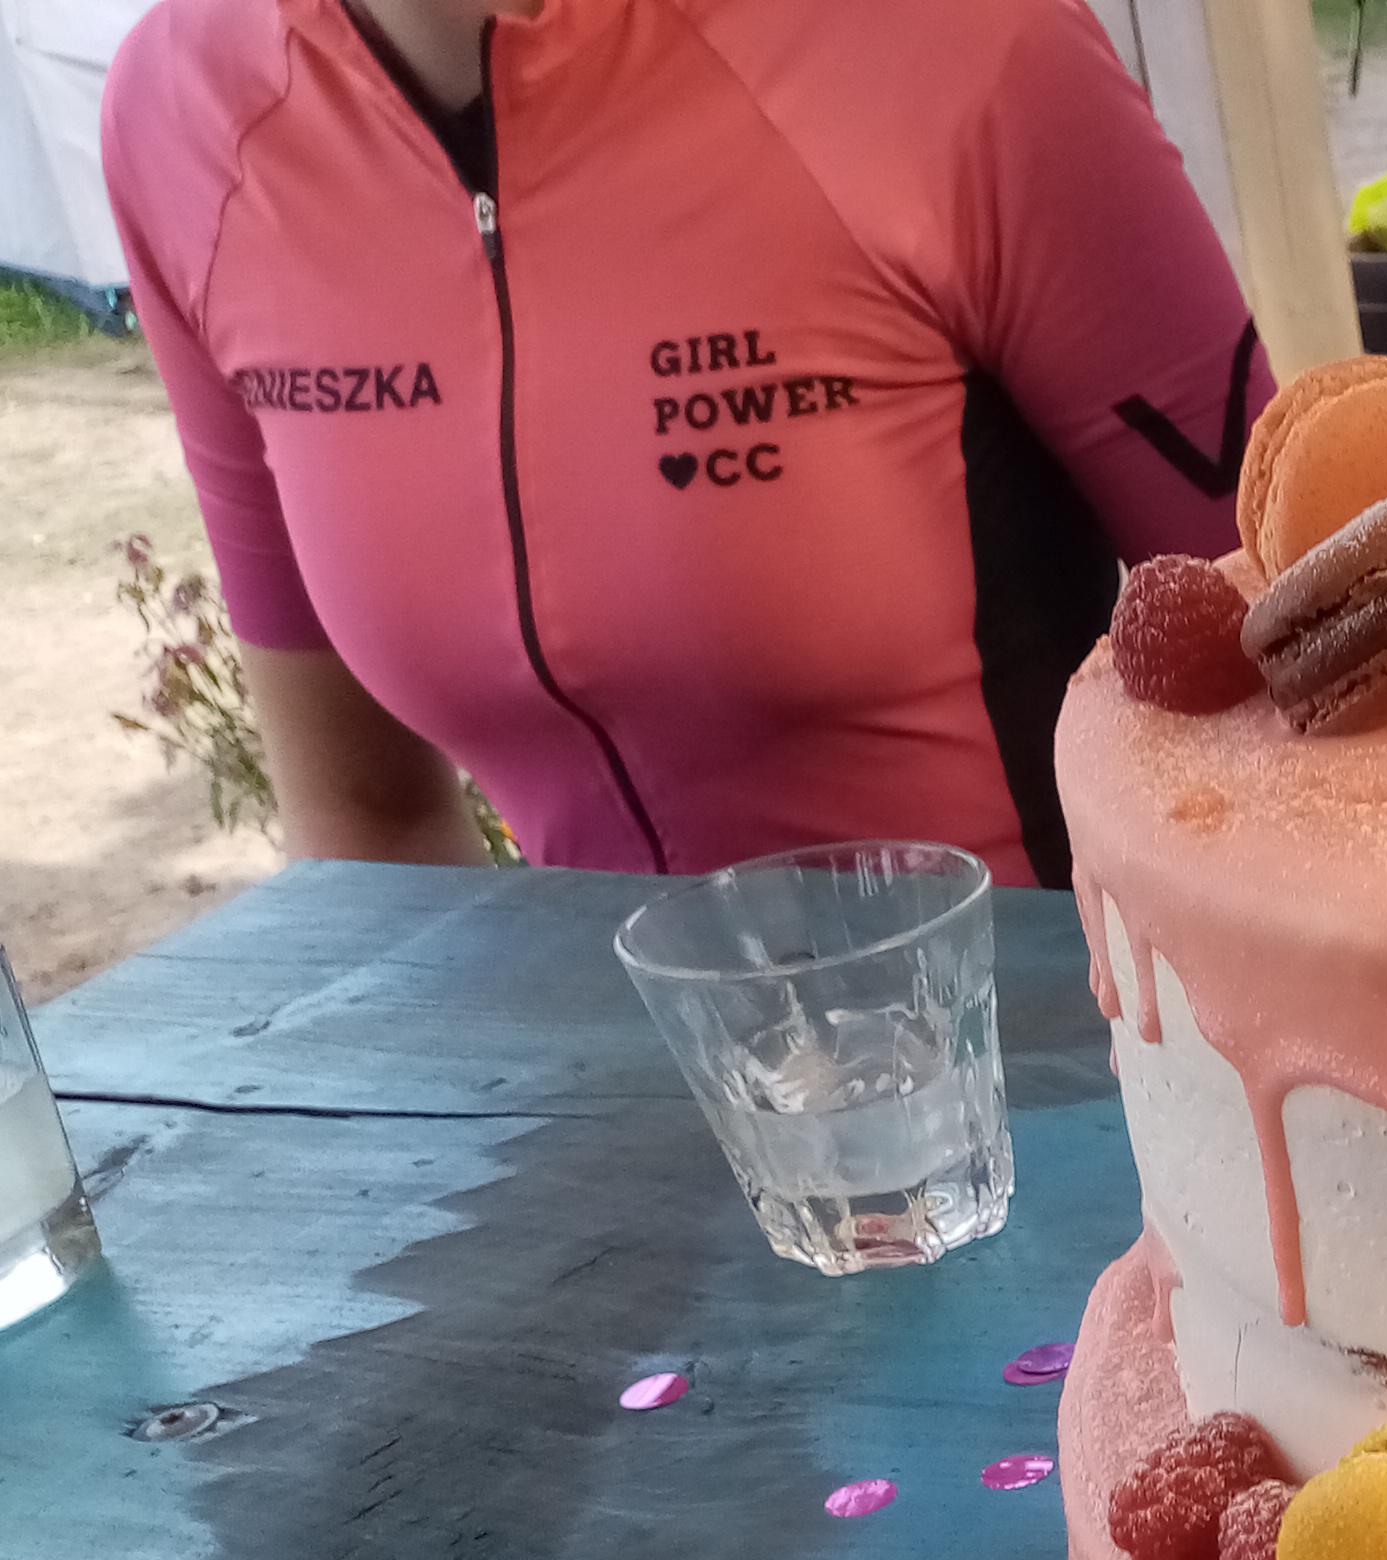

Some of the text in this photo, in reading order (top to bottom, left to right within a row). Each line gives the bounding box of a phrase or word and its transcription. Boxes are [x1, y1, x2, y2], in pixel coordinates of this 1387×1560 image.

[651, 331, 776, 376] GIRL
[654, 376, 859, 435] POWER
[706, 442, 783, 486] CC
